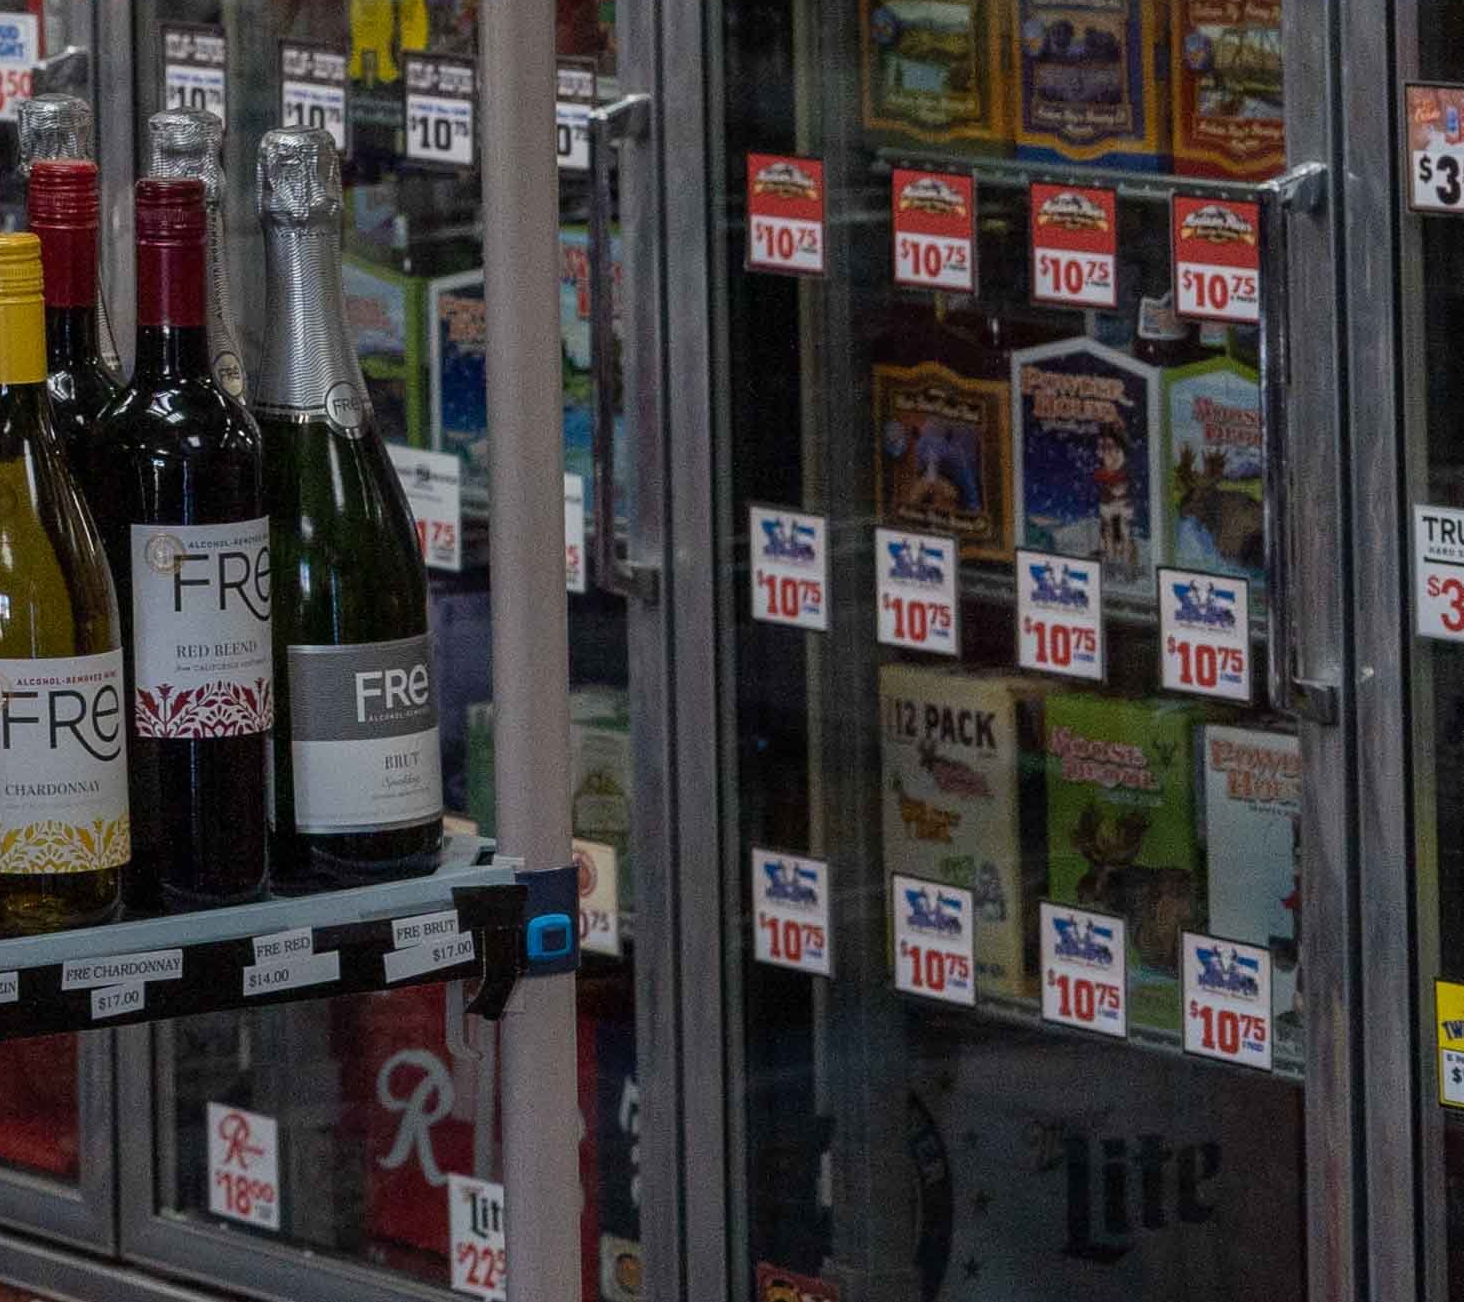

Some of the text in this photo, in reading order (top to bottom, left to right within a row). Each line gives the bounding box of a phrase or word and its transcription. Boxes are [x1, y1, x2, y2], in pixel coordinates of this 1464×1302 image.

[176, 640, 258, 659] RED BLEND
[893, 699, 998, 750] 12 PACK
[384, 750, 421, 773] BRUT
[5, 779, 101, 798] CHARDONNAY
[396, 919, 456, 941] FRE BRUT
[256, 936, 311, 958] FRE RED
[432, 940, 473, 961] $17.00
[65, 957, 182, 982] FRE CHARDONNAY
[248, 968, 290, 987] $14.00
[98, 991, 139, 1009] $17.00
